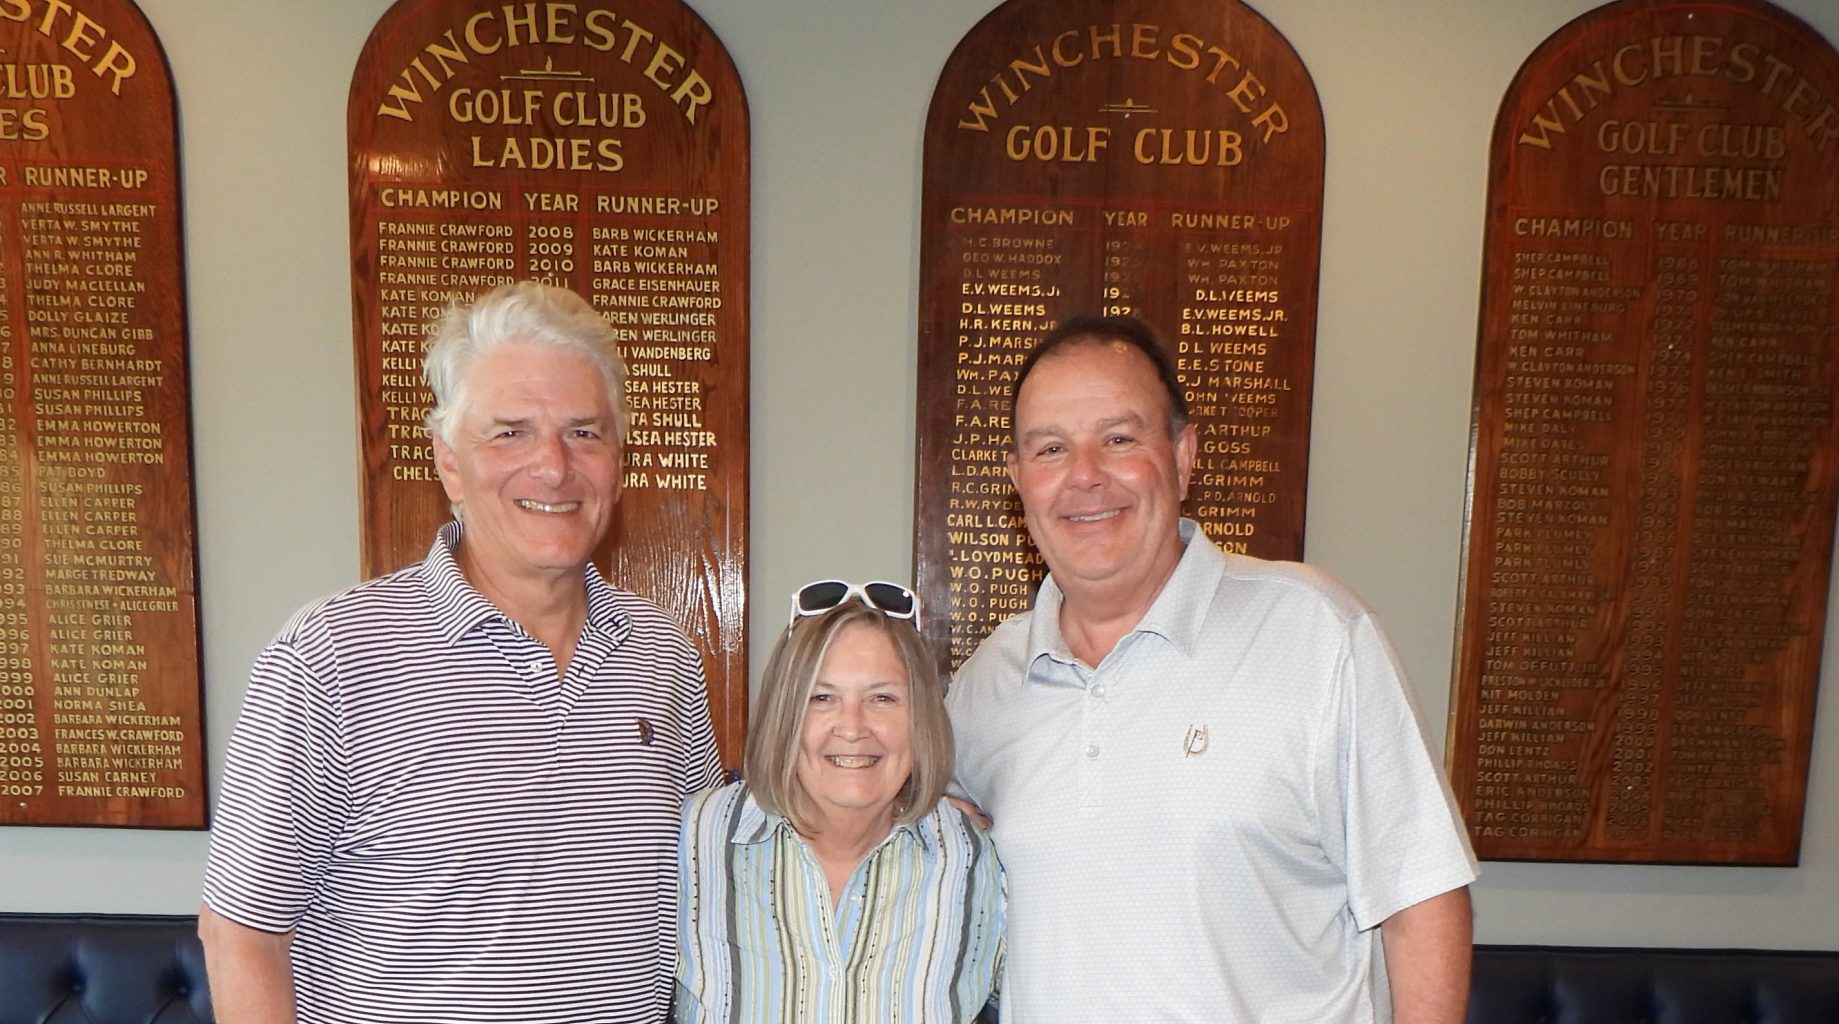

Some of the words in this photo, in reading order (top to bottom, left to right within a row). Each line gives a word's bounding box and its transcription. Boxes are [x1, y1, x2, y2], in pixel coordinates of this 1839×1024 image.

[377, 2, 714, 127] WINCHESTER
[957, 23, 1290, 144] WINCHESTER
[1519, 35, 1839, 150] WINCHESTER
[449, 88, 544, 126] GOLF
[553, 90, 647, 129] CLUB
[1006, 125, 1111, 163] GOLF
[1134, 128, 1243, 166] CLUB
[1600, 120, 1689, 154] GOLF
[1699, 122, 1786, 159] CLUB
[472, 135, 624, 172] LADIES
[25, 166, 148, 188] RUNNER-UP
[1600, 165, 1783, 200] GENTLEMEN
[381, 188, 502, 210] CHAMPION
[524, 192, 578, 213] YEAR
[597, 195, 719, 216] RUNNER-UP
[951, 208, 1074, 226] CHAMPION
[1105, 211, 1148, 227] YEAR
[1172, 213, 1290, 230] RUNNER-UP
[379, 222, 436, 236] FRANNIE
[440, 224, 512, 238] CRAWFORD
[529, 226, 574, 240] 2008
[1514, 218, 1632, 238] CHAMPION
[1654, 222, 1708, 242] YEAR
[593, 228, 629, 240] BARB
[633, 229, 718, 242] WICKERHAM
[380, 239, 436, 252] FRANNIE
[441, 240, 514, 254] CRAWFORD
[529, 243, 574, 256] 2009
[594, 244, 628, 257] KATE
[634, 246, 688, 258] KOMAN
[380, 256, 437, 268] FRANNIE
[442, 257, 514, 270] CRAWFORD
[530, 259, 574, 272] 2010
[1009, 254, 1062, 265] HADDOX
[594, 260, 630, 273] BARB
[635, 262, 718, 276] WICKERHAM
[26, 279, 60, 290] JUDY
[66, 280, 145, 292] MACLELLAN
[380, 272, 436, 285] FRANNIE
[441, 274, 514, 287] CRAWFORD
[593, 278, 635, 290] GRACE
[639, 279, 720, 292] EISENHAUER
[28, 295, 82, 306] THELMA
[88, 296, 135, 308] CLORE
[381, 290, 416, 302] KATE
[421, 290, 475, 303] KOMAN
[593, 295, 649, 307] FRANNIE
[652, 296, 722, 309] CRAWFORD
[28, 311, 68, 322] DOLLY
[74, 312, 128, 324] GLAIZE
[382, 306, 416, 319] KATE
[641, 313, 716, 326] WERLINGER
[382, 323, 418, 336] KATE
[642, 330, 716, 343] WERLINGER
[32, 342, 65, 353] ANNA
[70, 344, 136, 356] LINEBURG
[382, 340, 416, 352] KATE
[1210, 342, 1267, 355] WEEMS
[632, 346, 711, 360] VANDENBERG
[30, 358, 76, 369] CATHY
[82, 359, 162, 372] BERNHARDT
[382, 358, 416, 370] KELLI
[632, 364, 672, 376] SHULL
[382, 374, 416, 387] KELLI
[1506, 377, 1560, 389] STEVEN
[653, 382, 700, 394] HESTER
[34, 388, 80, 400] SUSAN
[84, 389, 142, 402] PHILLIPS
[382, 391, 416, 404] KELLI
[653, 397, 702, 410] HESTER
[653, 412, 702, 427] SHULL
[37, 420, 80, 431] EMMA
[84, 421, 160, 434] HOWERTON
[37, 436, 80, 447] EMMA
[84, 437, 162, 449] HOWERTON
[665, 432, 717, 446] HESTER
[952, 448, 998, 461] CLARKE
[1501, 453, 1546, 464] SCOTT
[658, 454, 708, 469] WHITE
[1500, 468, 1545, 479] BOBBY
[656, 474, 706, 490] WHITE
[42, 511, 78, 521] ELLEN
[84, 512, 136, 522] CARPER
[1198, 506, 1256, 518] GRIMM
[947, 514, 982, 528] CARL
[44, 540, 94, 550] THELMA
[100, 540, 143, 550] CLORE
[948, 532, 1009, 546] WILSON
[44, 554, 68, 565] SUE
[73, 555, 152, 566] MCMURTRY
[46, 570, 88, 580] MARGE
[92, 570, 156, 582] TREDWAY
[992, 568, 1043, 581] PUGH
[990, 584, 1028, 595] PUGH
[990, 598, 1028, 609] PUGH
[49, 614, 86, 625] ALICE
[92, 615, 132, 626] GRIER
[50, 644, 84, 654] KATE
[92, 645, 144, 656] KOMAN
[53, 672, 90, 684] ALICE
[98, 674, 138, 684] GRIER
[54, 686, 80, 697] ANN
[86, 686, 140, 698] DUNLAP
[54, 700, 102, 710] NORMA
[109, 701, 146, 712] SHEA
[54, 714, 102, 724] BARBARA
[106, 715, 180, 726] WICKERHAM
[0, 727, 38, 739] 2003
[0, 743, 42, 754] 2004
[56, 744, 107, 755] BARBARA
[110, 744, 180, 756] WICKERHAM
[0, 756, 44, 768] 2005
[58, 758, 109, 768] BARBARA
[113, 758, 182, 769] WICKERHAM
[0, 770, 42, 782] 2006
[58, 772, 99, 782] SUSAN
[105, 772, 156, 783] CARNEY
[2, 785, 43, 796] 2007
[58, 786, 112, 797] FRANNIE
[116, 786, 184, 798] CRAWFORD
